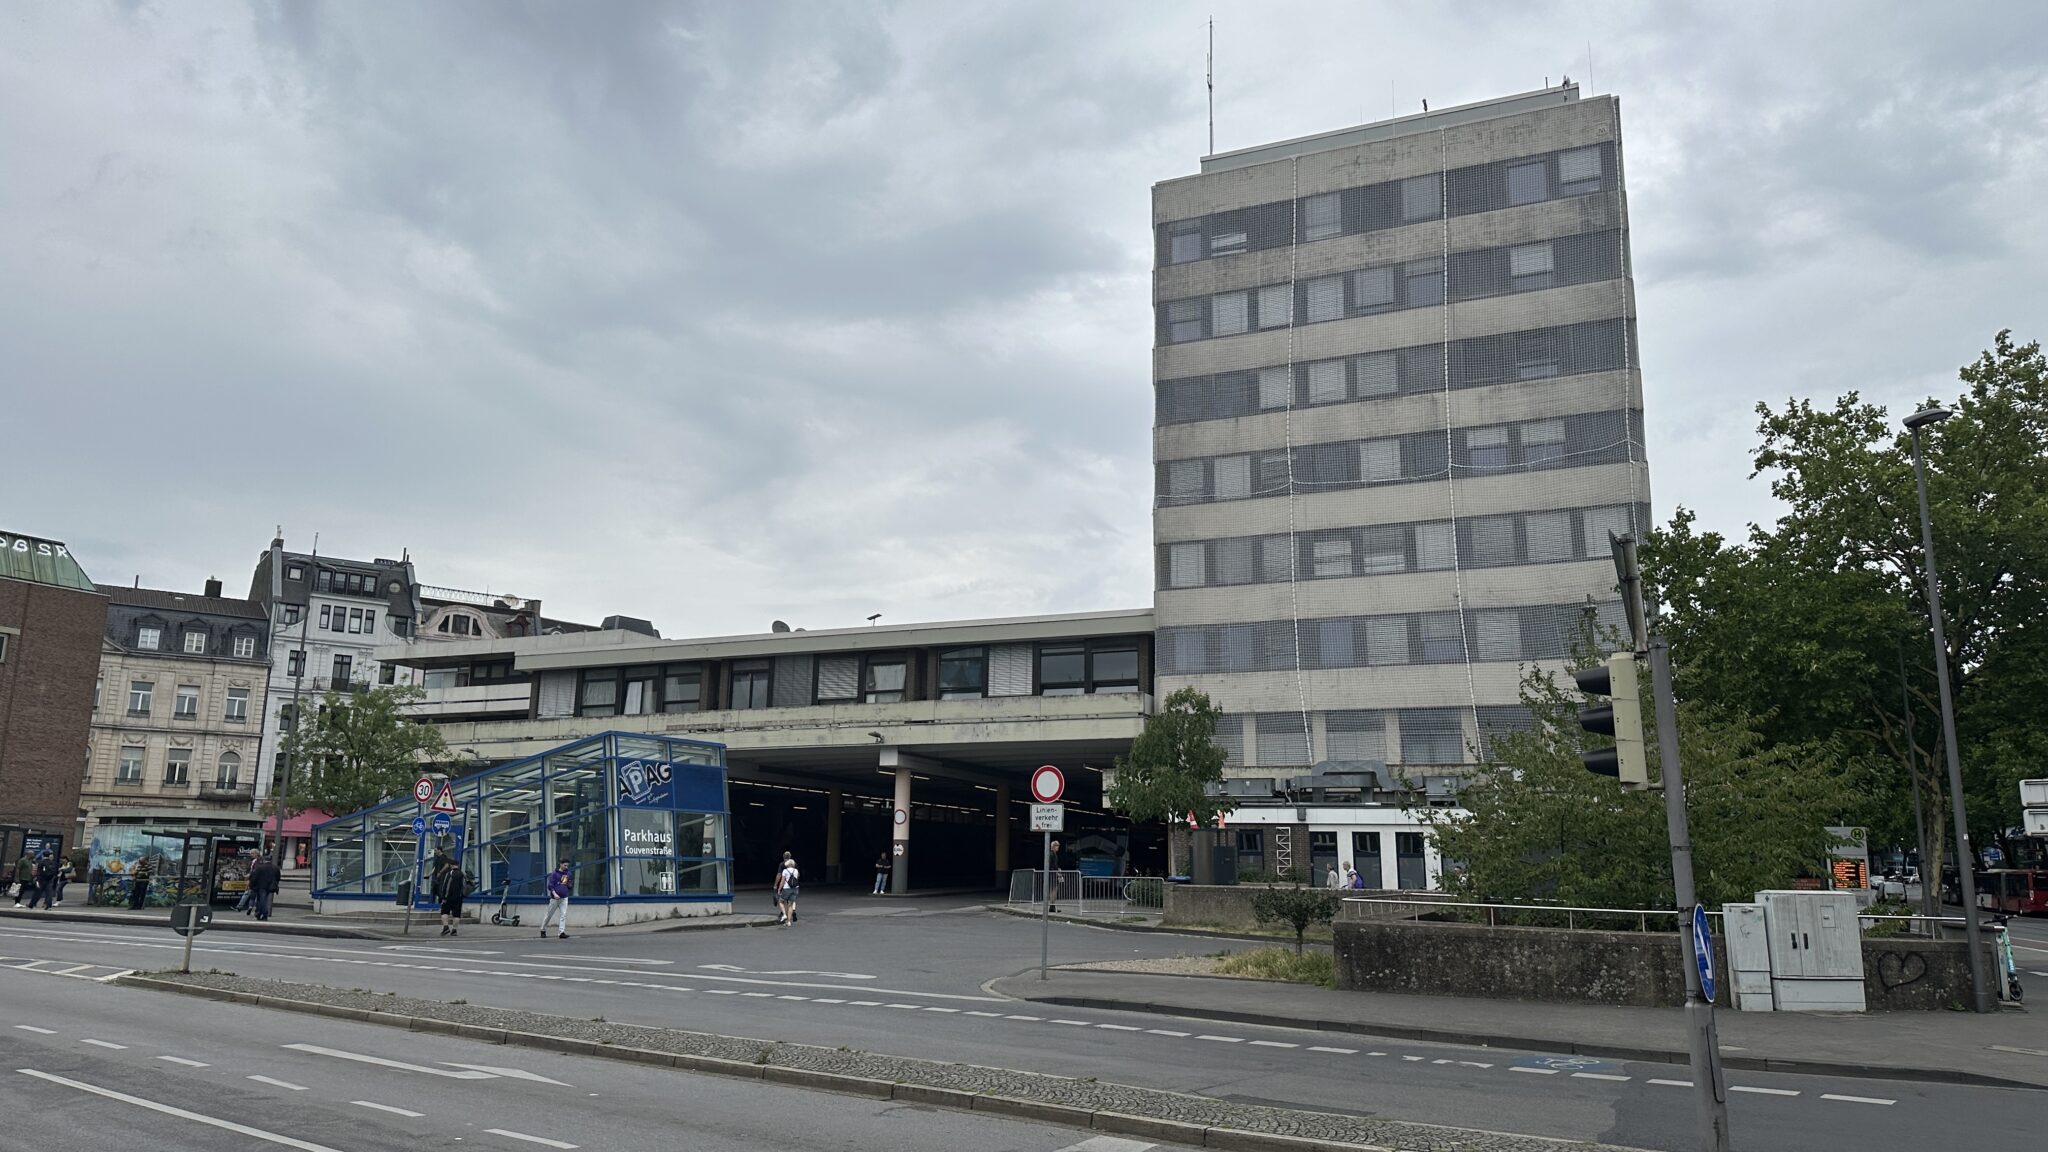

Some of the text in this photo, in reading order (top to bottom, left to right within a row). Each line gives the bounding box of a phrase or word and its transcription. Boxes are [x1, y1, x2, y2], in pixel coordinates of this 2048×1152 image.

[418, 785, 430, 796] 30
[624, 829, 672, 843] Parkhaus
[625, 845, 673, 855] Couvenstraße
